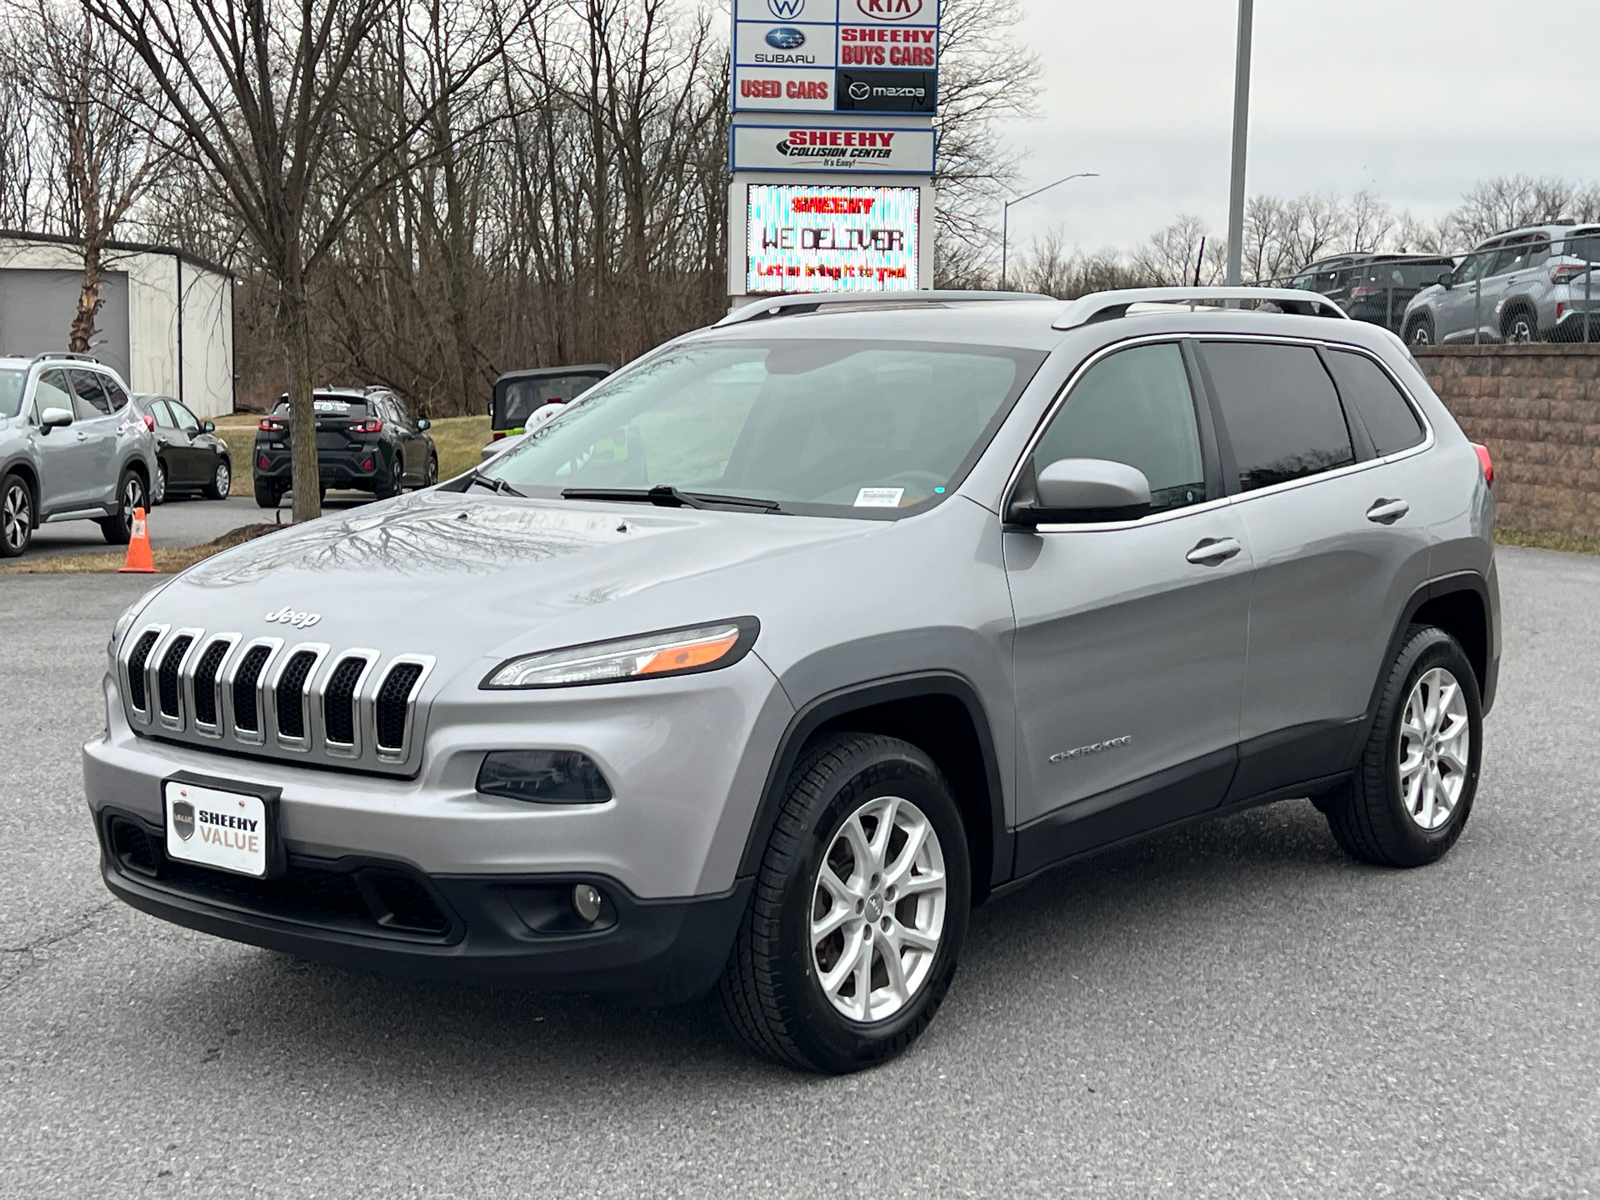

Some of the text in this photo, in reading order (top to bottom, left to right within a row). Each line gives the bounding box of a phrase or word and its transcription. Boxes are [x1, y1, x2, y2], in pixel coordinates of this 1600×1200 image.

[868, 0, 912, 13] KIA
[841, 28, 935, 43] SHEEHY
[754, 53, 816, 64] SUBARU
[841, 45, 935, 66] BUYS CARS
[740, 79, 828, 100] USED CARS
[788, 130, 895, 147] SHEEHY
[789, 146, 892, 158] COLLISION CENTER
[823, 158, 856, 168] It's Easy!
[762, 227, 904, 250] WE DELIVER
[265, 606, 322, 629] Jeep
[199, 810, 258, 832] SHEEHY
[199, 825, 258, 853] VALUE
